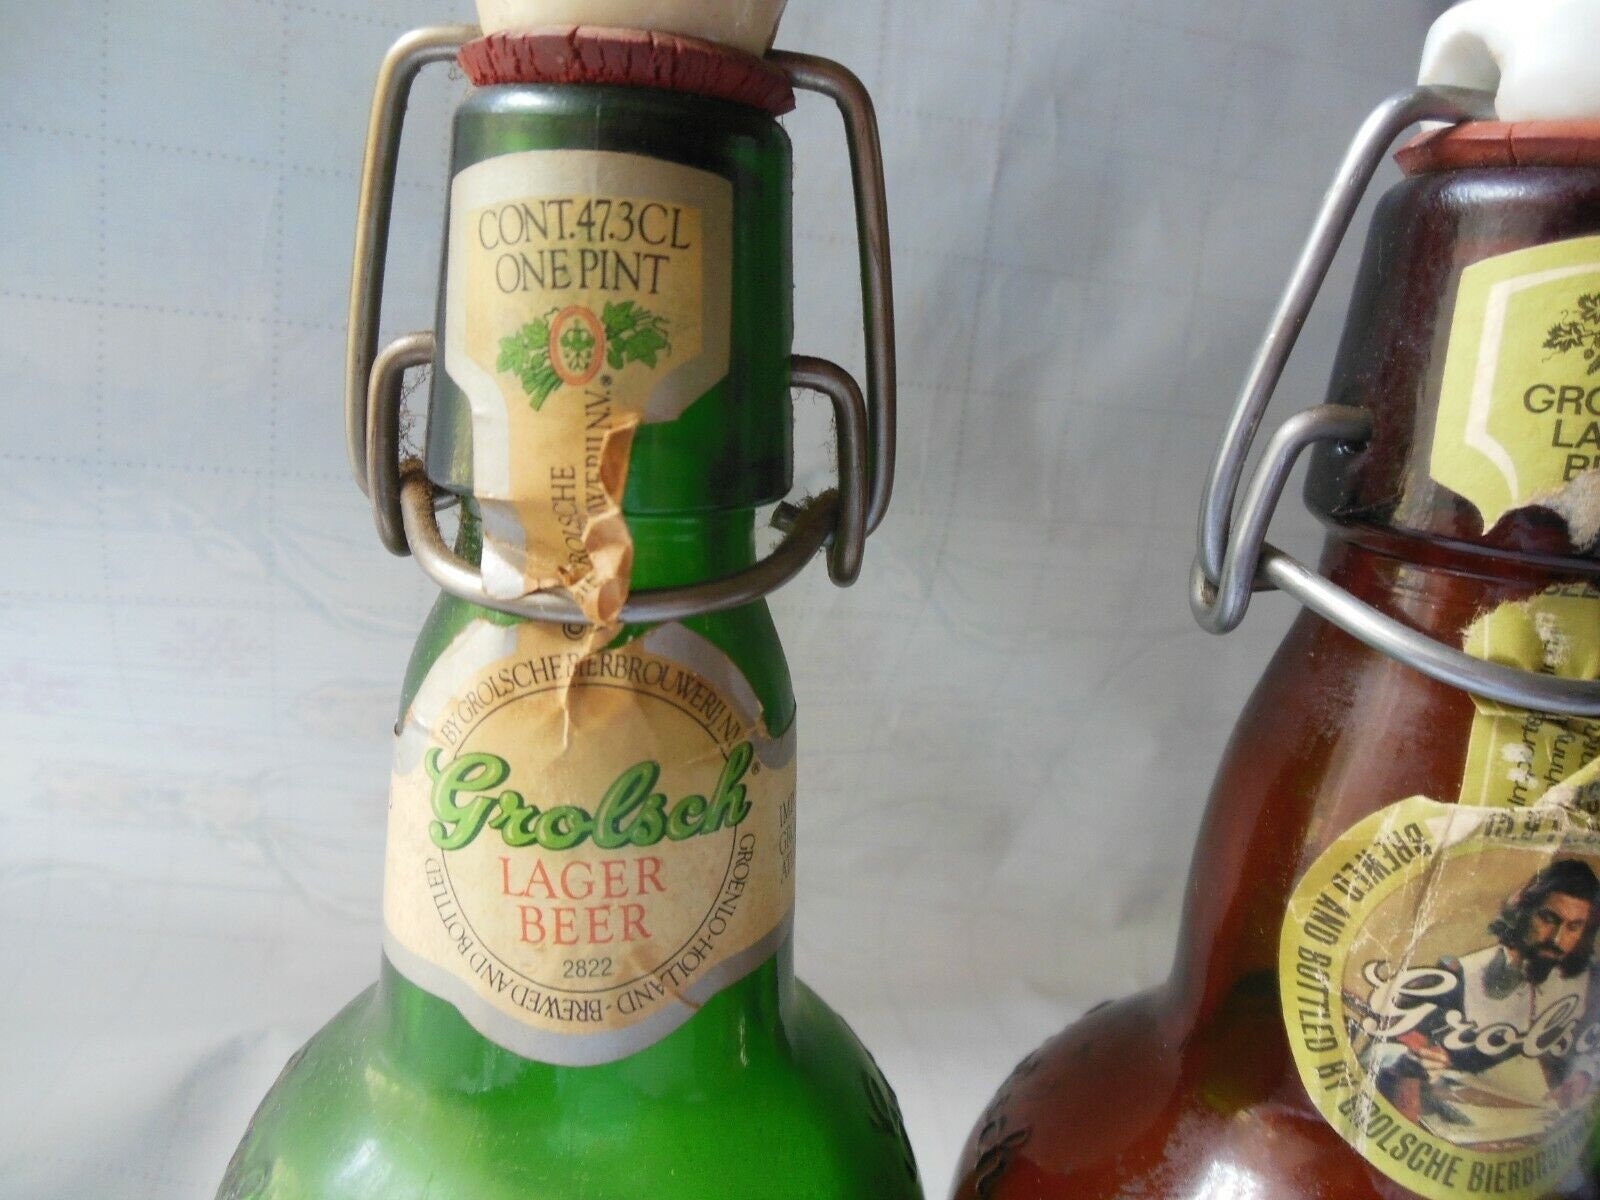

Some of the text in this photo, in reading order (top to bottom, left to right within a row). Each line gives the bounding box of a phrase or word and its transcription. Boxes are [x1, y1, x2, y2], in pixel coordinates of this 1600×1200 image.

[495, 248, 671, 295] ONE PINT
[440, 711, 463, 746] BY
[457, 653, 561, 724] GROLSCHE
[424, 740, 755, 851] Grolsch
[498, 855, 668, 901] LAGER
[1330, 821, 1434, 903] BREWED
[424, 857, 474, 956] BOTTLED
[518, 901, 654, 948] BEER
[1302, 891, 1351, 946] AND
[468, 950, 515, 994] AND
[561, 958, 615, 980] 2822
[510, 984, 604, 1023] BREWED
[1295, 945, 1339, 1052] BOTTLED
[1316, 1059, 1359, 1093] BY
